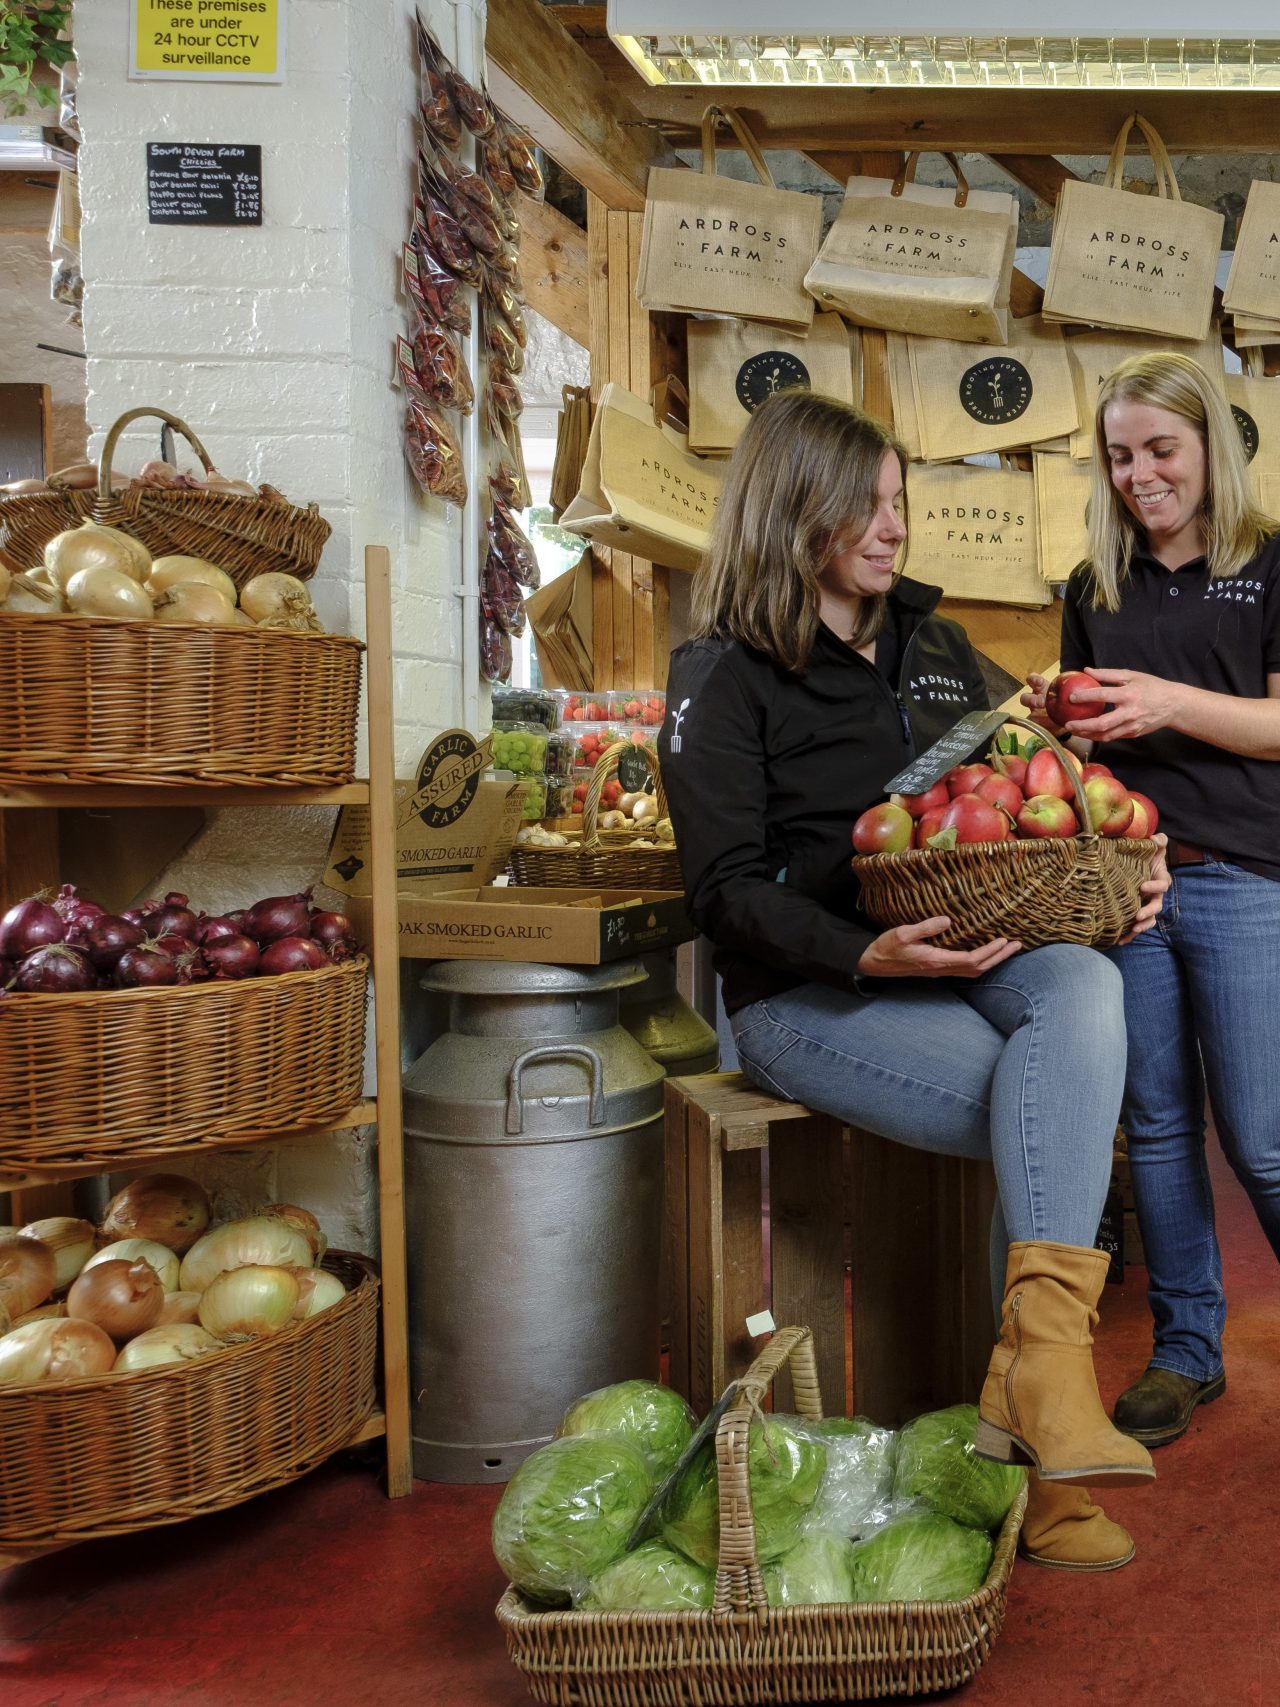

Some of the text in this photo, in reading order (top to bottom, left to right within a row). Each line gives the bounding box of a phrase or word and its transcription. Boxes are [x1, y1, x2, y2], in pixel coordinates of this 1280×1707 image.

[198, 0, 267, 13] premises
[171, 17, 242, 29] are under
[154, 32, 260, 48] 24 hour CCTV
[162, 51, 251, 65] surveillance
[184, 146, 214, 157] DEVON
[218, 148, 245, 157] FARM
[679, 218, 787, 248] ARDROSS
[868, 224, 967, 248] ARDROSS
[701, 243, 761, 262] FARM
[885, 243, 940, 260] FARM
[1090, 231, 1190, 261] ARDROSS
[1108, 255, 1163, 277] FARM
[642, 457, 719, 506] ARDROSS
[660, 485, 706, 516] FARM
[926, 507, 1024, 526] ARDROSS
[947, 531, 1003, 544] FARM
[909, 675, 964, 690] ARDROSS
[929, 692, 960, 702] FARM
[423, 739, 467, 777] GARLIC
[409, 753, 483, 817] ASSURED
[432, 790, 472, 823] FARM
[400, 846, 487, 862] SMOKED GARLIC
[427, 923, 492, 937] SMOKED
[494, 925, 552, 940] GARLIC
